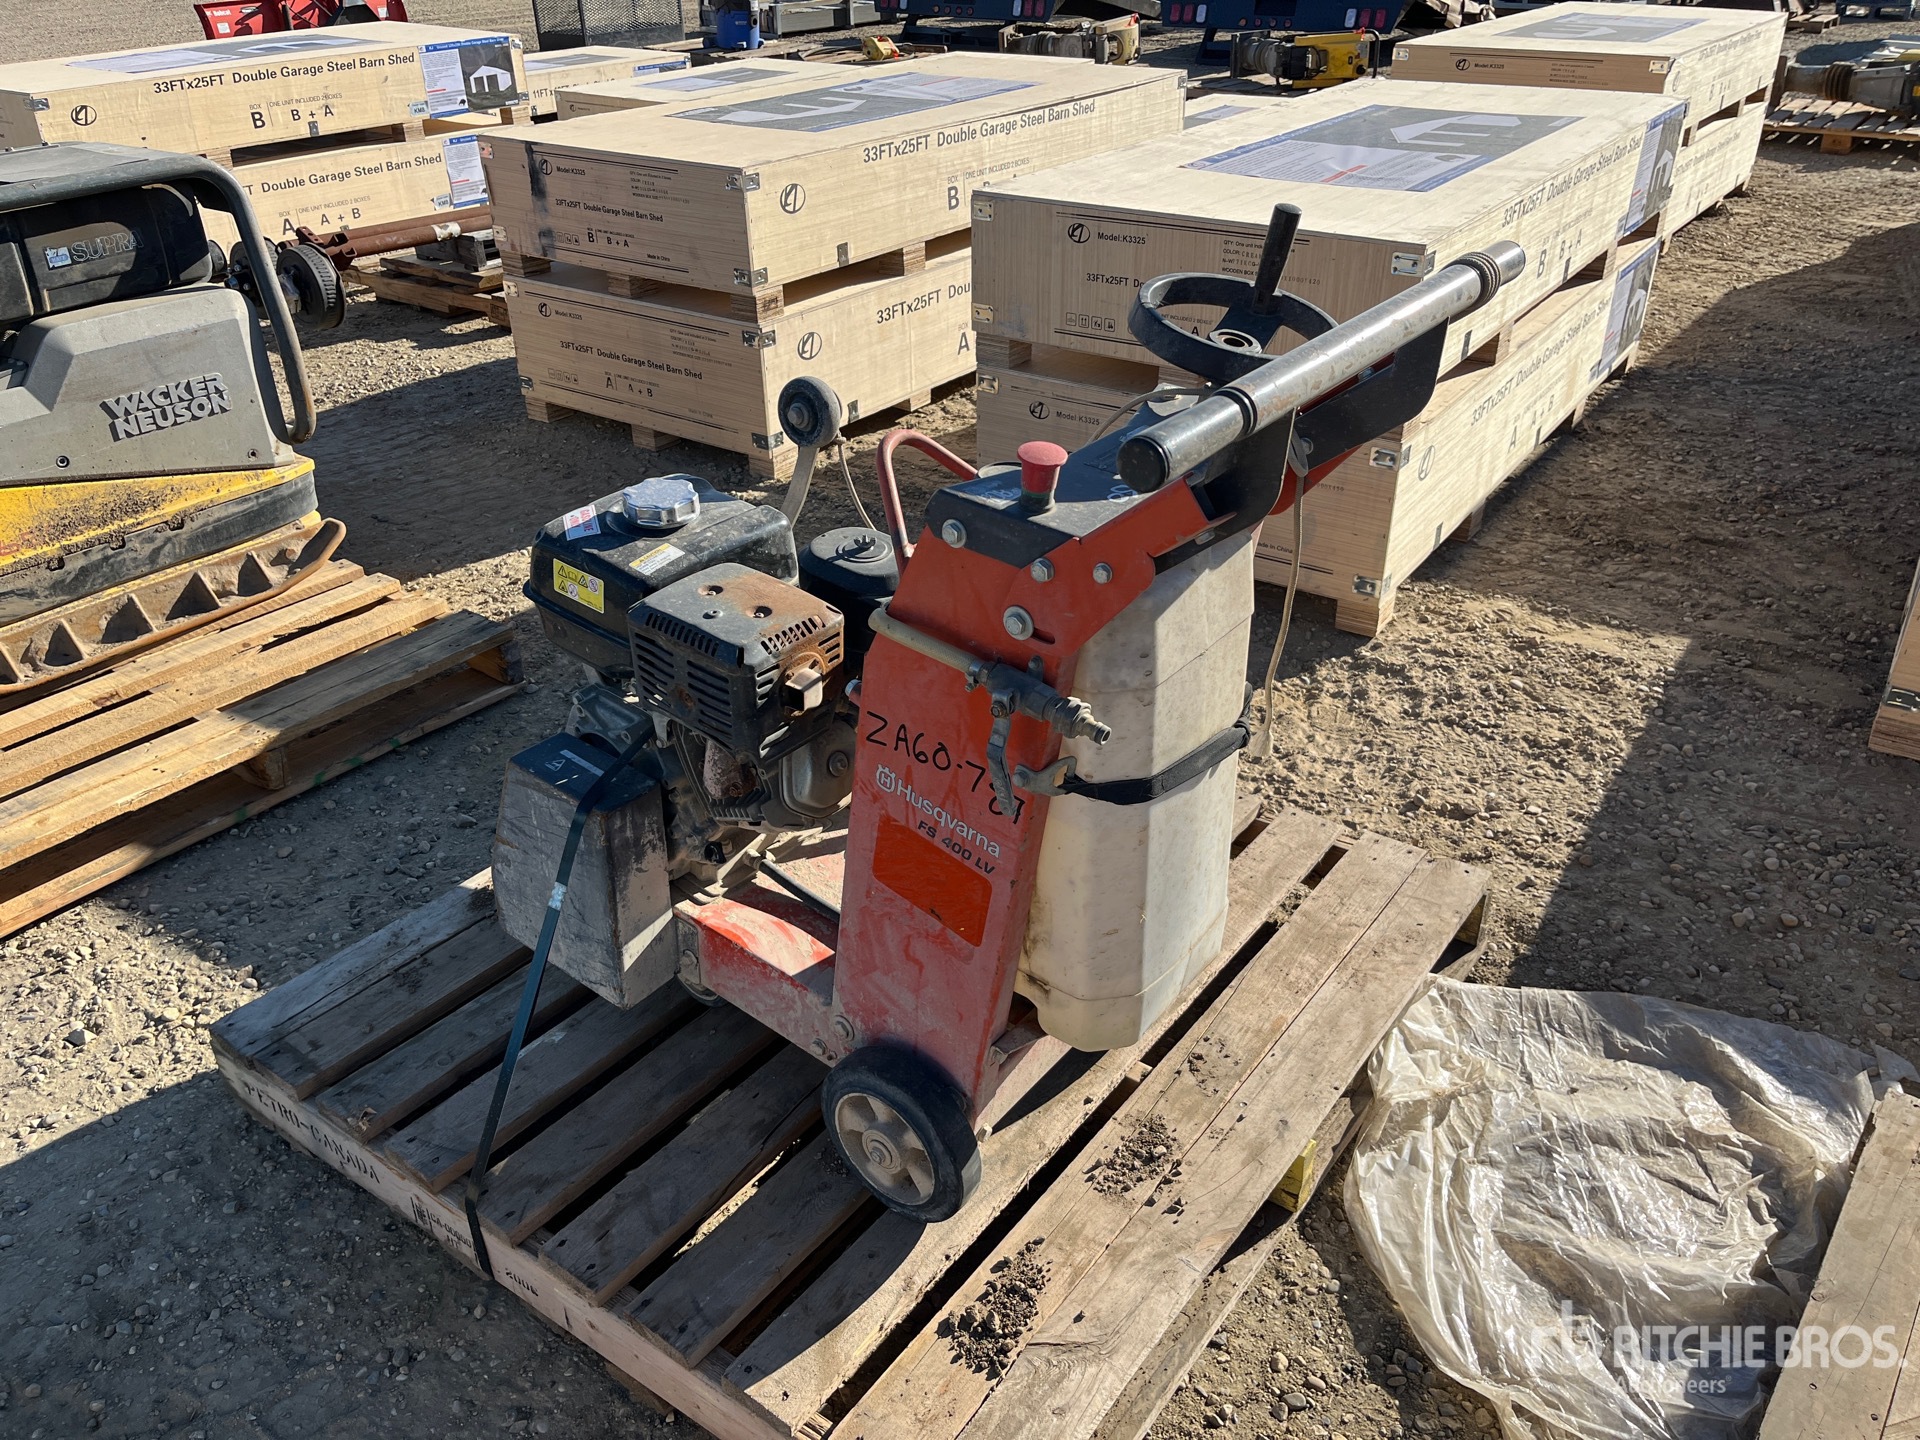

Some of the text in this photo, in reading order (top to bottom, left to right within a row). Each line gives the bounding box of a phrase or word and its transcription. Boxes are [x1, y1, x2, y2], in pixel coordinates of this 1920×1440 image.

[154, 52, 415, 94] 33FTx25FT Double Garage Steel Barn Shed
[249, 102, 262, 110] BOX
[269, 100, 281, 108] ONE
[282, 98, 295, 106] UNIT
[291, 108, 302, 122] B
[324, 104, 334, 118] A
[251, 110, 266, 130] B
[863, 99, 1096, 164] 33FTx25FT Double Garage Steel Barn Shed
[261, 178, 306, 194] Double
[308, 170, 352, 186] Garage
[354, 162, 384, 178] Steel
[386, 159, 412, 172] Barn
[414, 153, 442, 167] Shed
[948, 174, 959, 184] BOX
[965, 170, 976, 180] ONE
[976, 167, 988, 178] UNIT
[1502, 187, 1546, 228] 33FTx25FT
[1546, 174, 1573, 202] Double
[1573, 162, 1597, 188] Garage
[1596, 150, 1614, 173] Steel
[1613, 144, 1628, 164] Barn
[298, 206, 310, 214] ONE
[310, 204, 324, 212] UNIT
[324, 200, 350, 210] INCLUDED
[354, 195, 371, 204] BOXES
[947, 186, 960, 211] B
[278, 210, 291, 218] BOX
[320, 214, 331, 226] A
[351, 207, 362, 220] B
[622, 208, 636, 218] Steel
[636, 210, 649, 220] Barn
[649, 212, 664, 222] Shed
[282, 218, 296, 236] A
[71, 230, 145, 262] SUPRA
[588, 232, 594, 243] B
[606, 236, 612, 245] B
[624, 239, 630, 248] A
[1098, 232, 1146, 245] Model:K3325
[1560, 240, 1566, 260] B
[1536, 248, 1547, 280] B
[1086, 272, 1129, 286] 33FTx25FT
[876, 282, 970, 324] 33FTx25FT Dou
[1191, 326, 1200, 336] A
[958, 332, 970, 356] A
[560, 340, 702, 380] 33FTx25FT Double Garage Steel Barn Shed
[606, 376, 614, 390] A
[628, 383, 634, 393] A
[646, 388, 653, 398] B
[100, 372, 229, 420] WACKER
[108, 391, 232, 442] NEUSON
[1508, 425, 1518, 454] A
[896, 778, 1000, 859] Husqvarna
[918, 820, 996, 876] FS 400 LV
[244, 1082, 380, 1184] PETRO-CANADA
